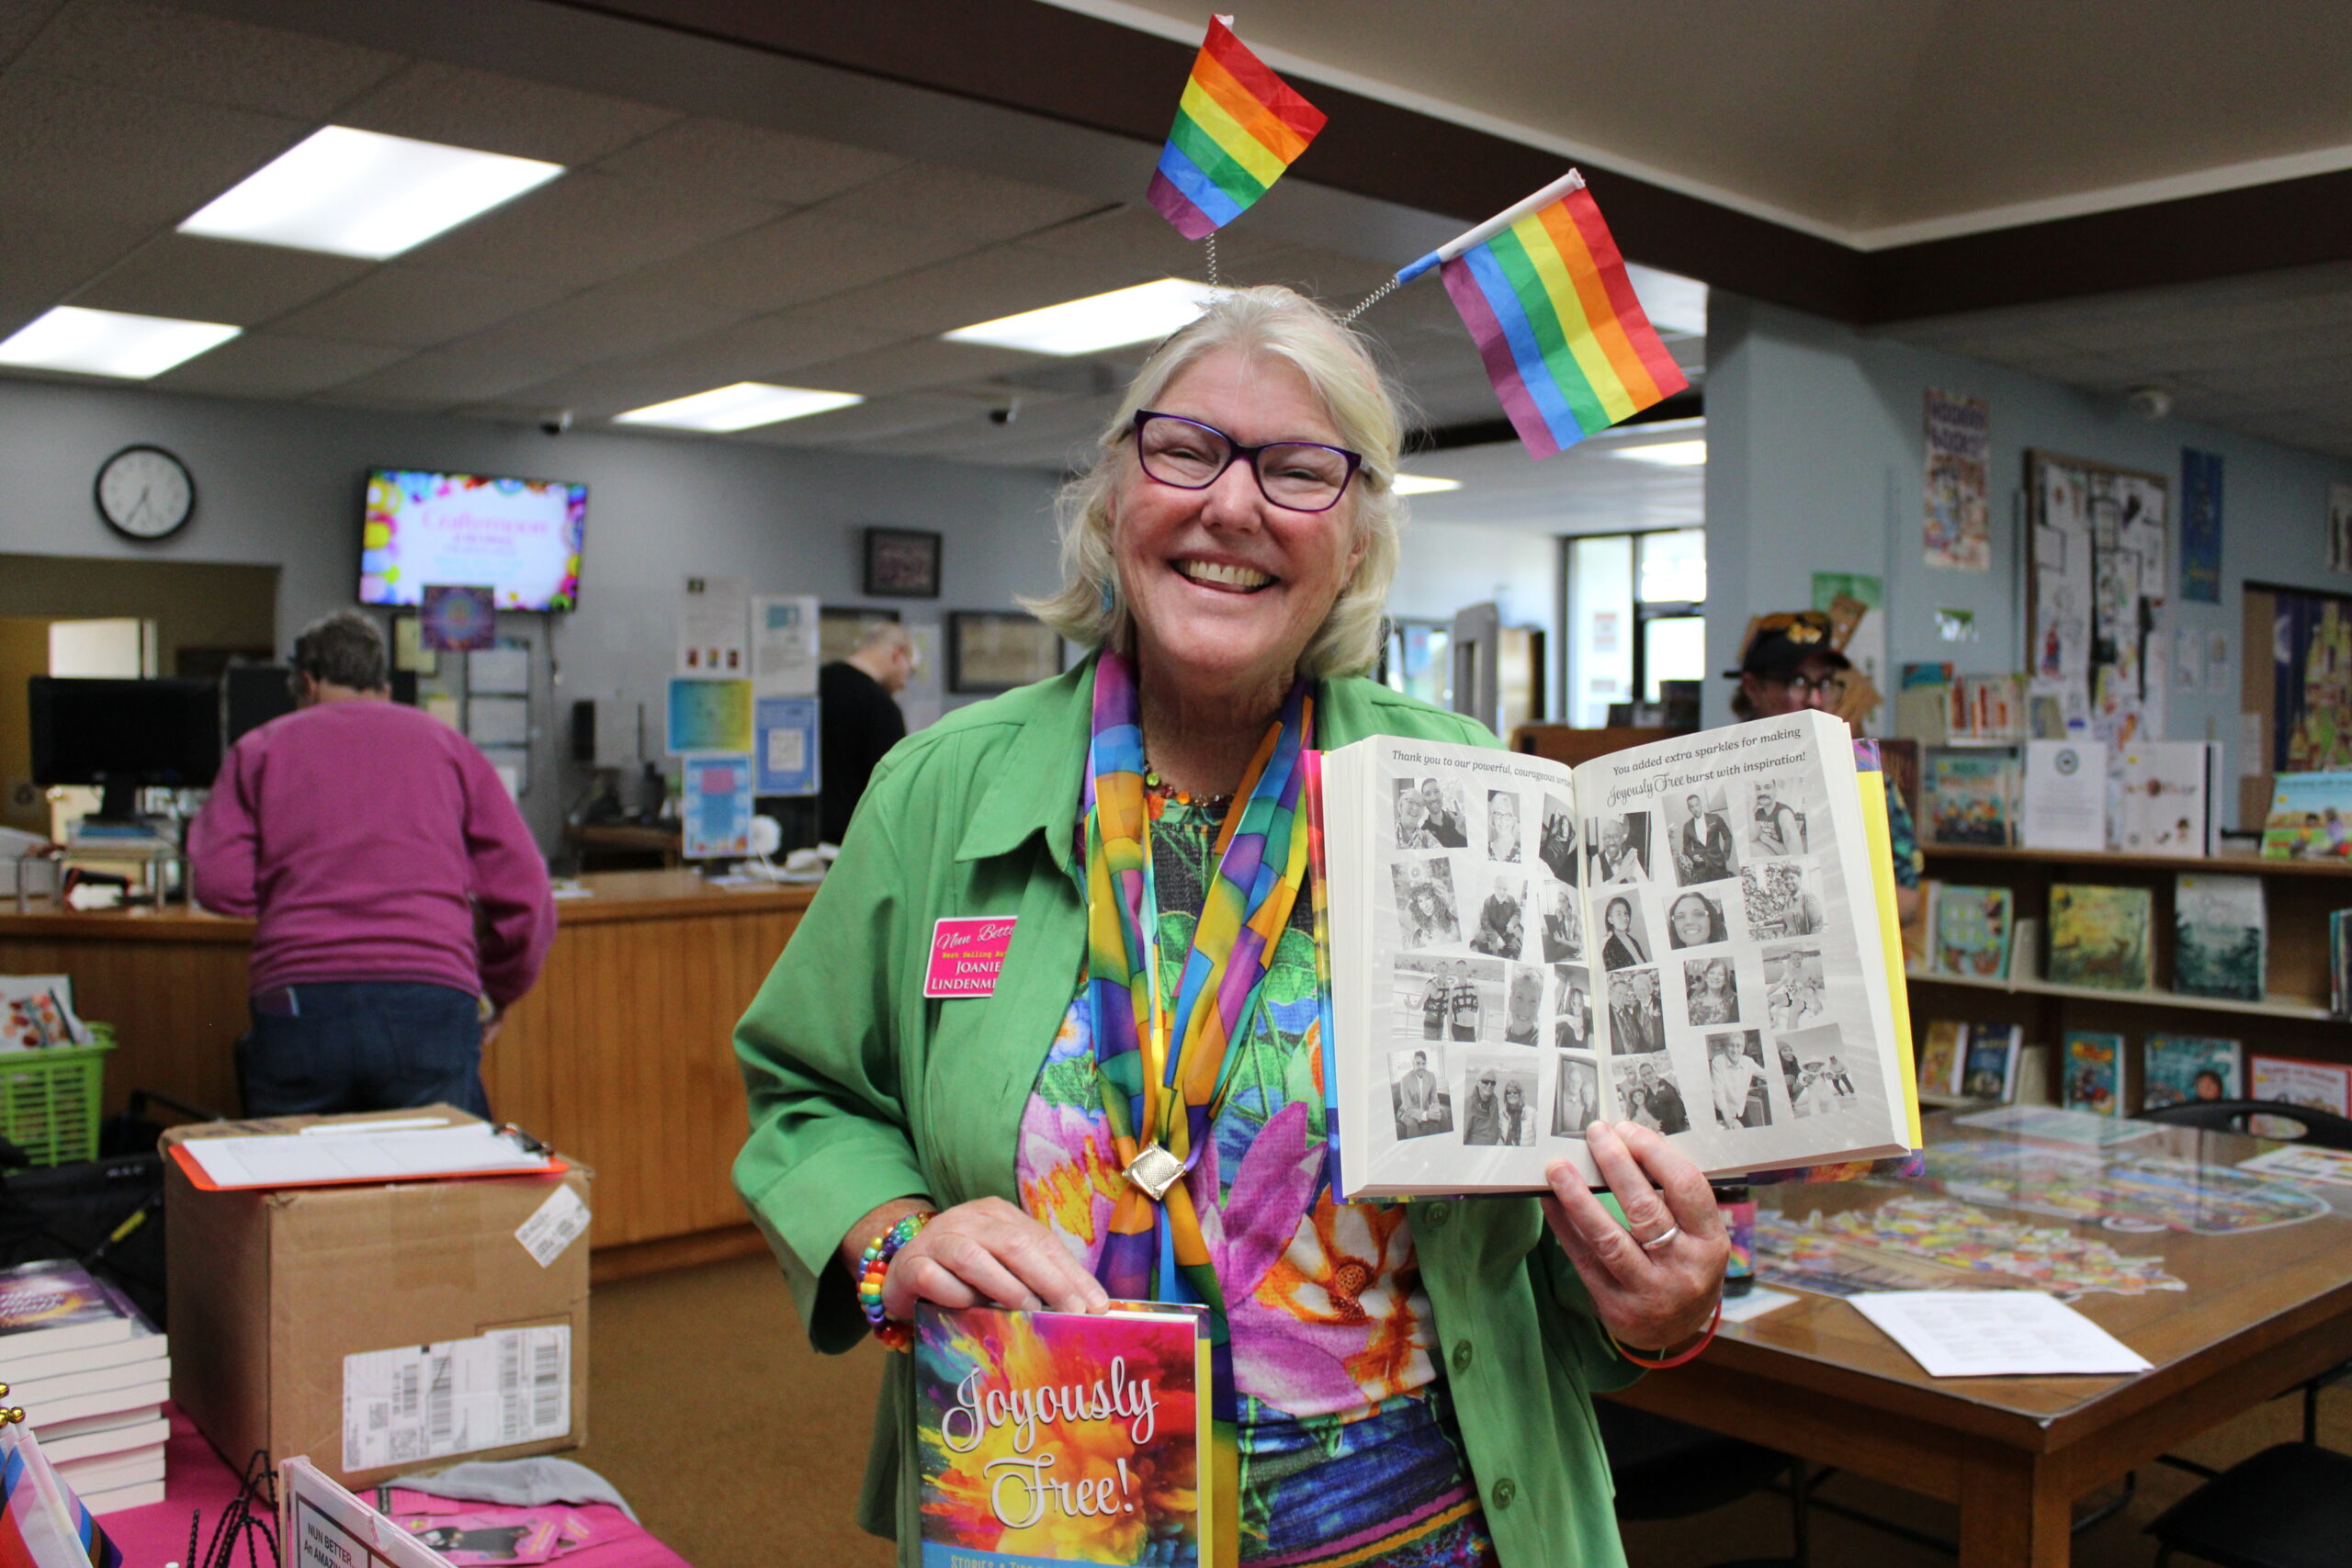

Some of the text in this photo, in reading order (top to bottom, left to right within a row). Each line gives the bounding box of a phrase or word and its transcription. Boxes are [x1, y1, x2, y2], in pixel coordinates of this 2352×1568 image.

[1613, 728, 1801, 776] You added extra sparkles for making
[1392, 750, 1421, 763] Thank
[1423, 756, 1442, 765] you
[1443, 757, 1453, 766] to
[1454, 760, 1471, 769] our
[1472, 761, 1513, 775] powerful,
[1514, 768, 1556, 782] courageous
[1607, 751, 1807, 807] Joyously Free burst with inspiration!
[936, 932, 971, 950] Nun
[956, 961, 1001, 975] JOANIE
[963, 950, 992, 960] Selling
[942, 1356, 1159, 1453] Joyously
[984, 1453, 1134, 1529] Free!
[308, 1522, 323, 1544] NUN
[303, 1540, 313, 1556] An
